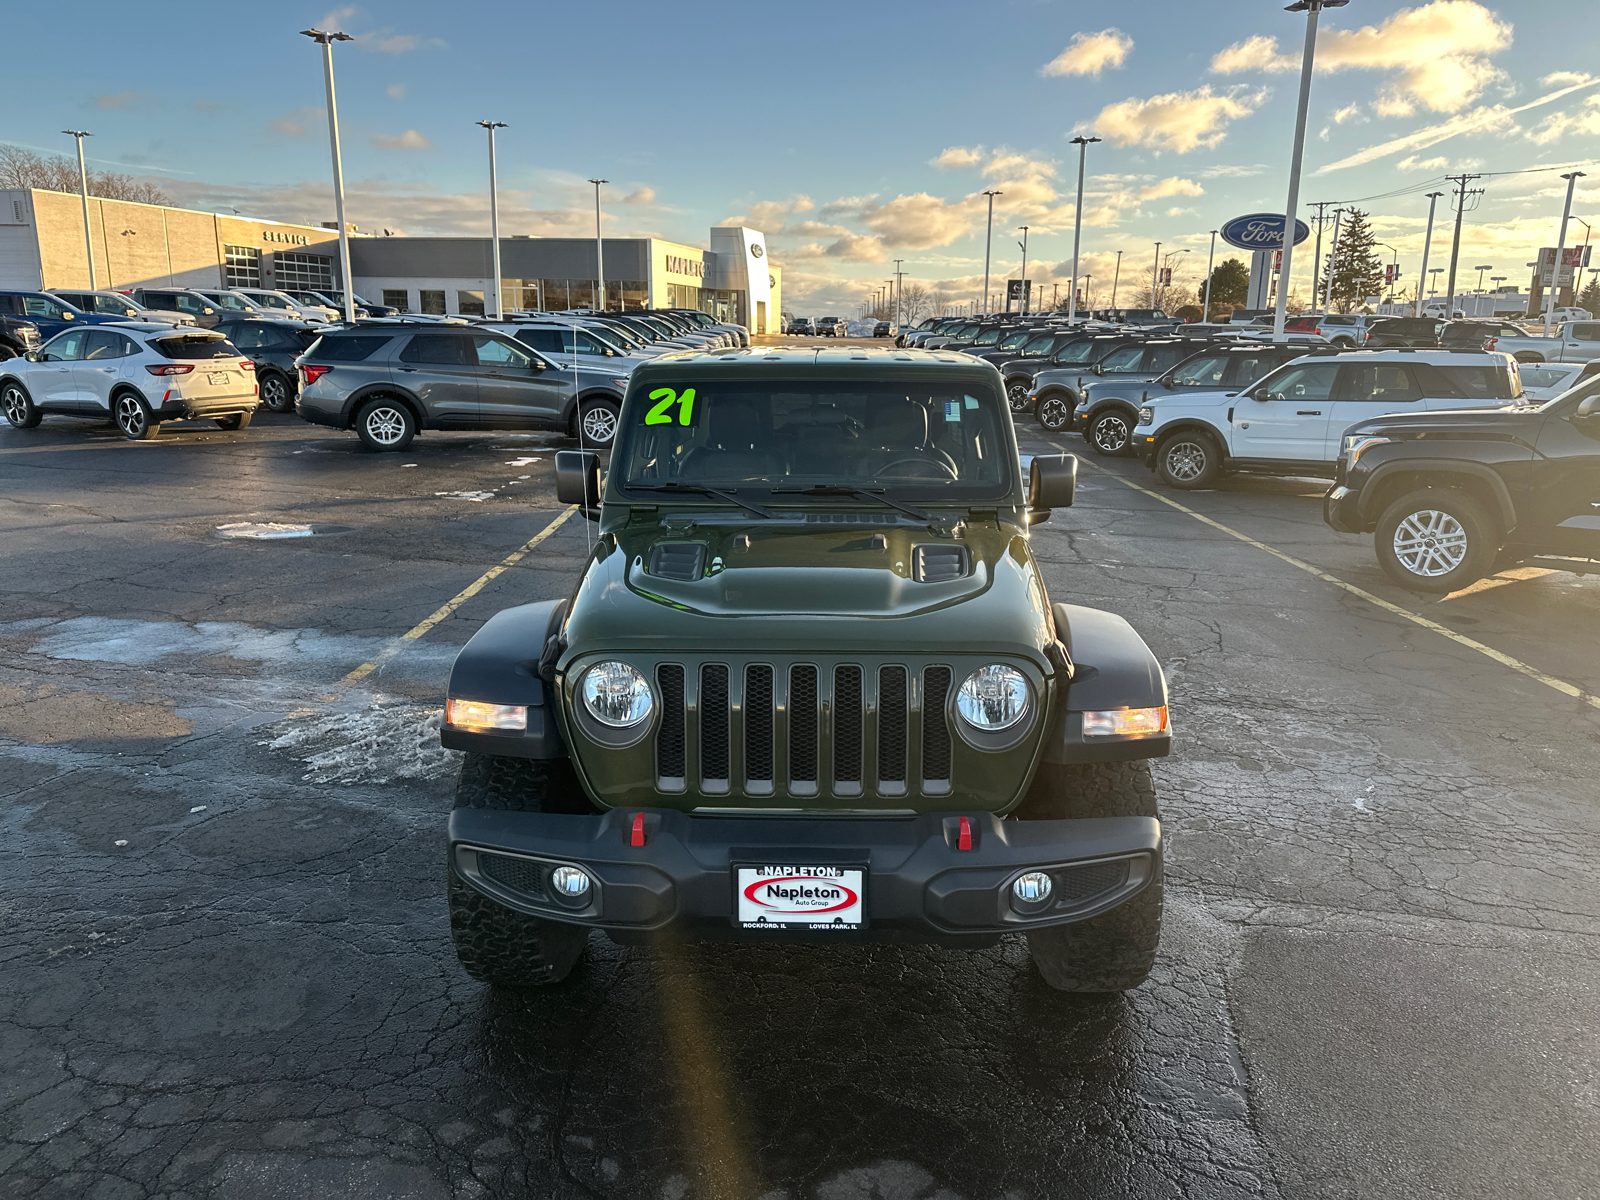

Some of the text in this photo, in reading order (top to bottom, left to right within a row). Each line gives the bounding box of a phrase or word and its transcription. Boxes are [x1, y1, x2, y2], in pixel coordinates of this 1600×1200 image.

[263, 231, 311, 246] SERVICE
[665, 254, 713, 279] NAPLETON
[645, 387, 696, 426] 21
[764, 866, 836, 877] NAPLETON
[767, 885, 840, 901] Napleton
